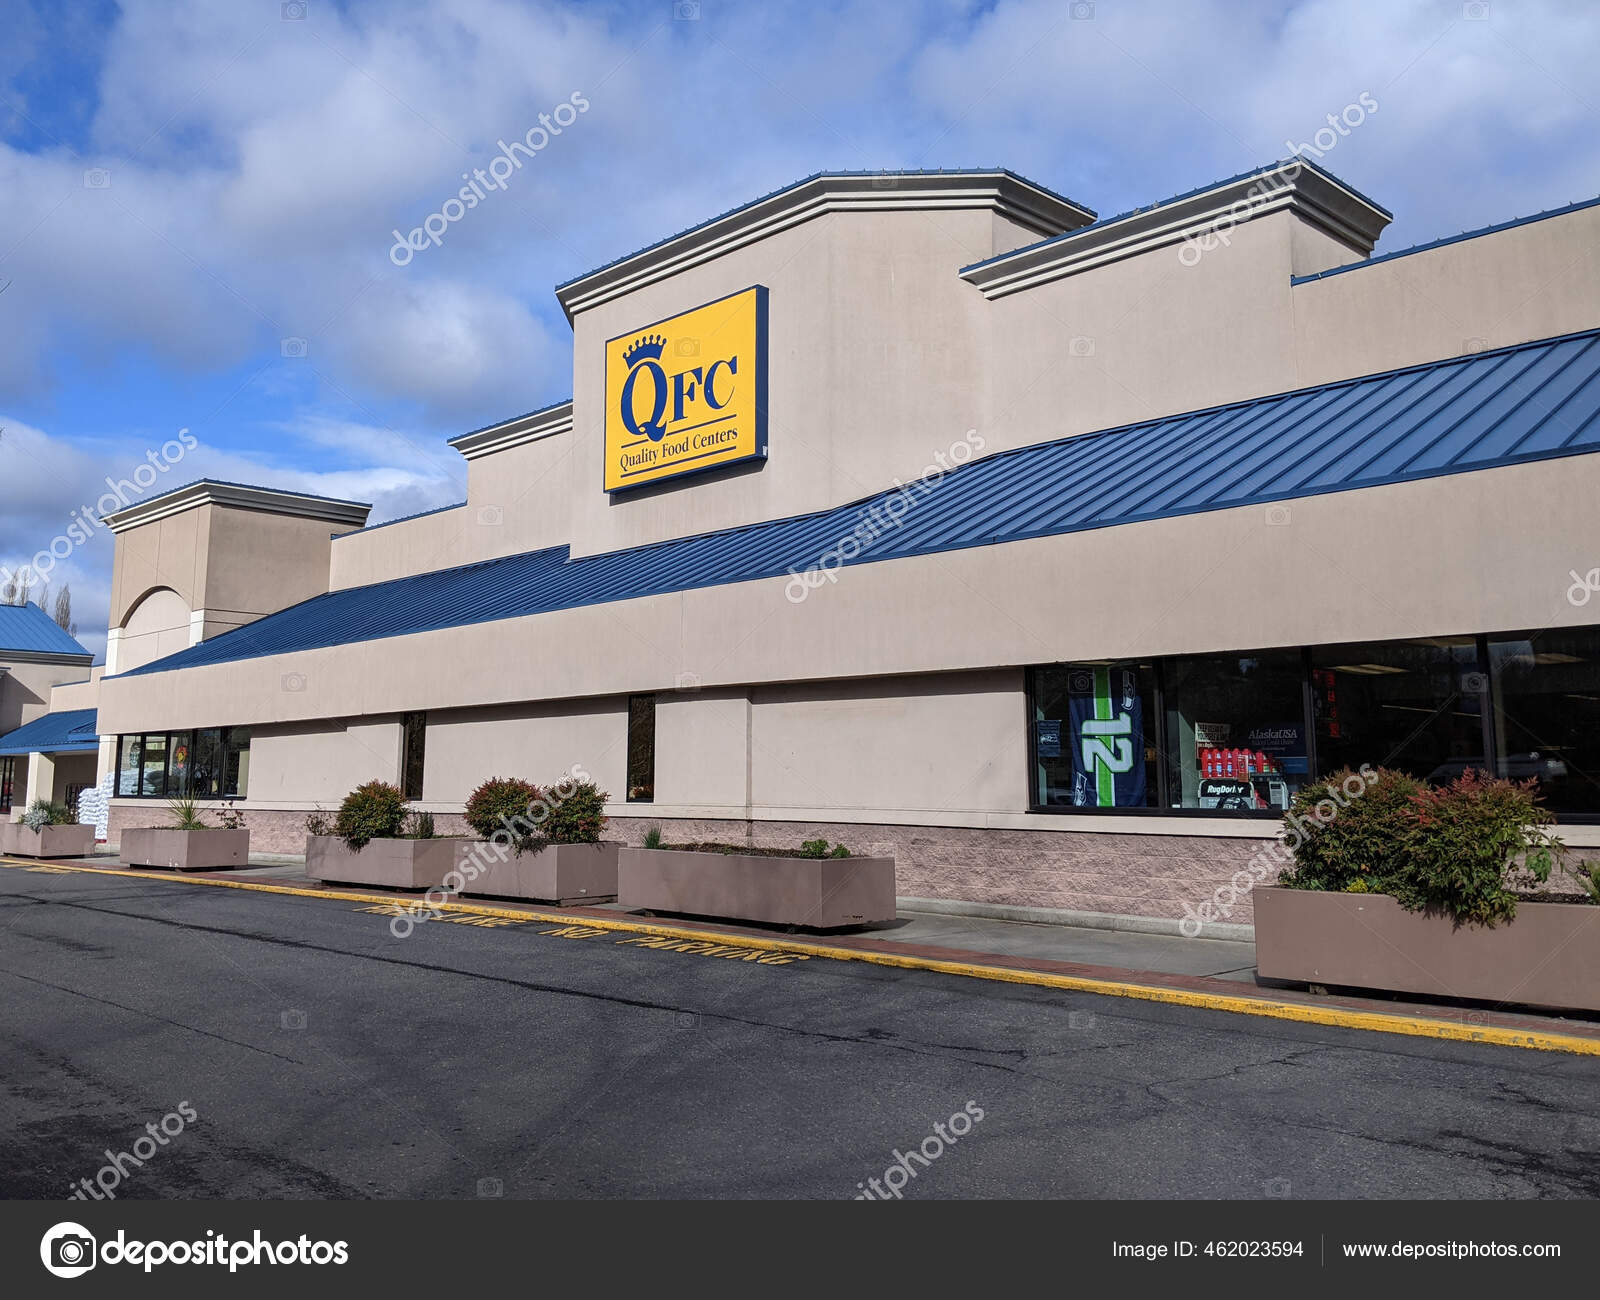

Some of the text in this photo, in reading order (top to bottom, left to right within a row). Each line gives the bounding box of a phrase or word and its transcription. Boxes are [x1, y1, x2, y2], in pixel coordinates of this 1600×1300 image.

[620, 355, 738, 442] QFC
[620, 427, 738, 472] Quality Food Centers
[1081, 711, 1134, 773] 12
[537, 926, 609, 939] NO
[615, 936, 811, 965] PARKING
